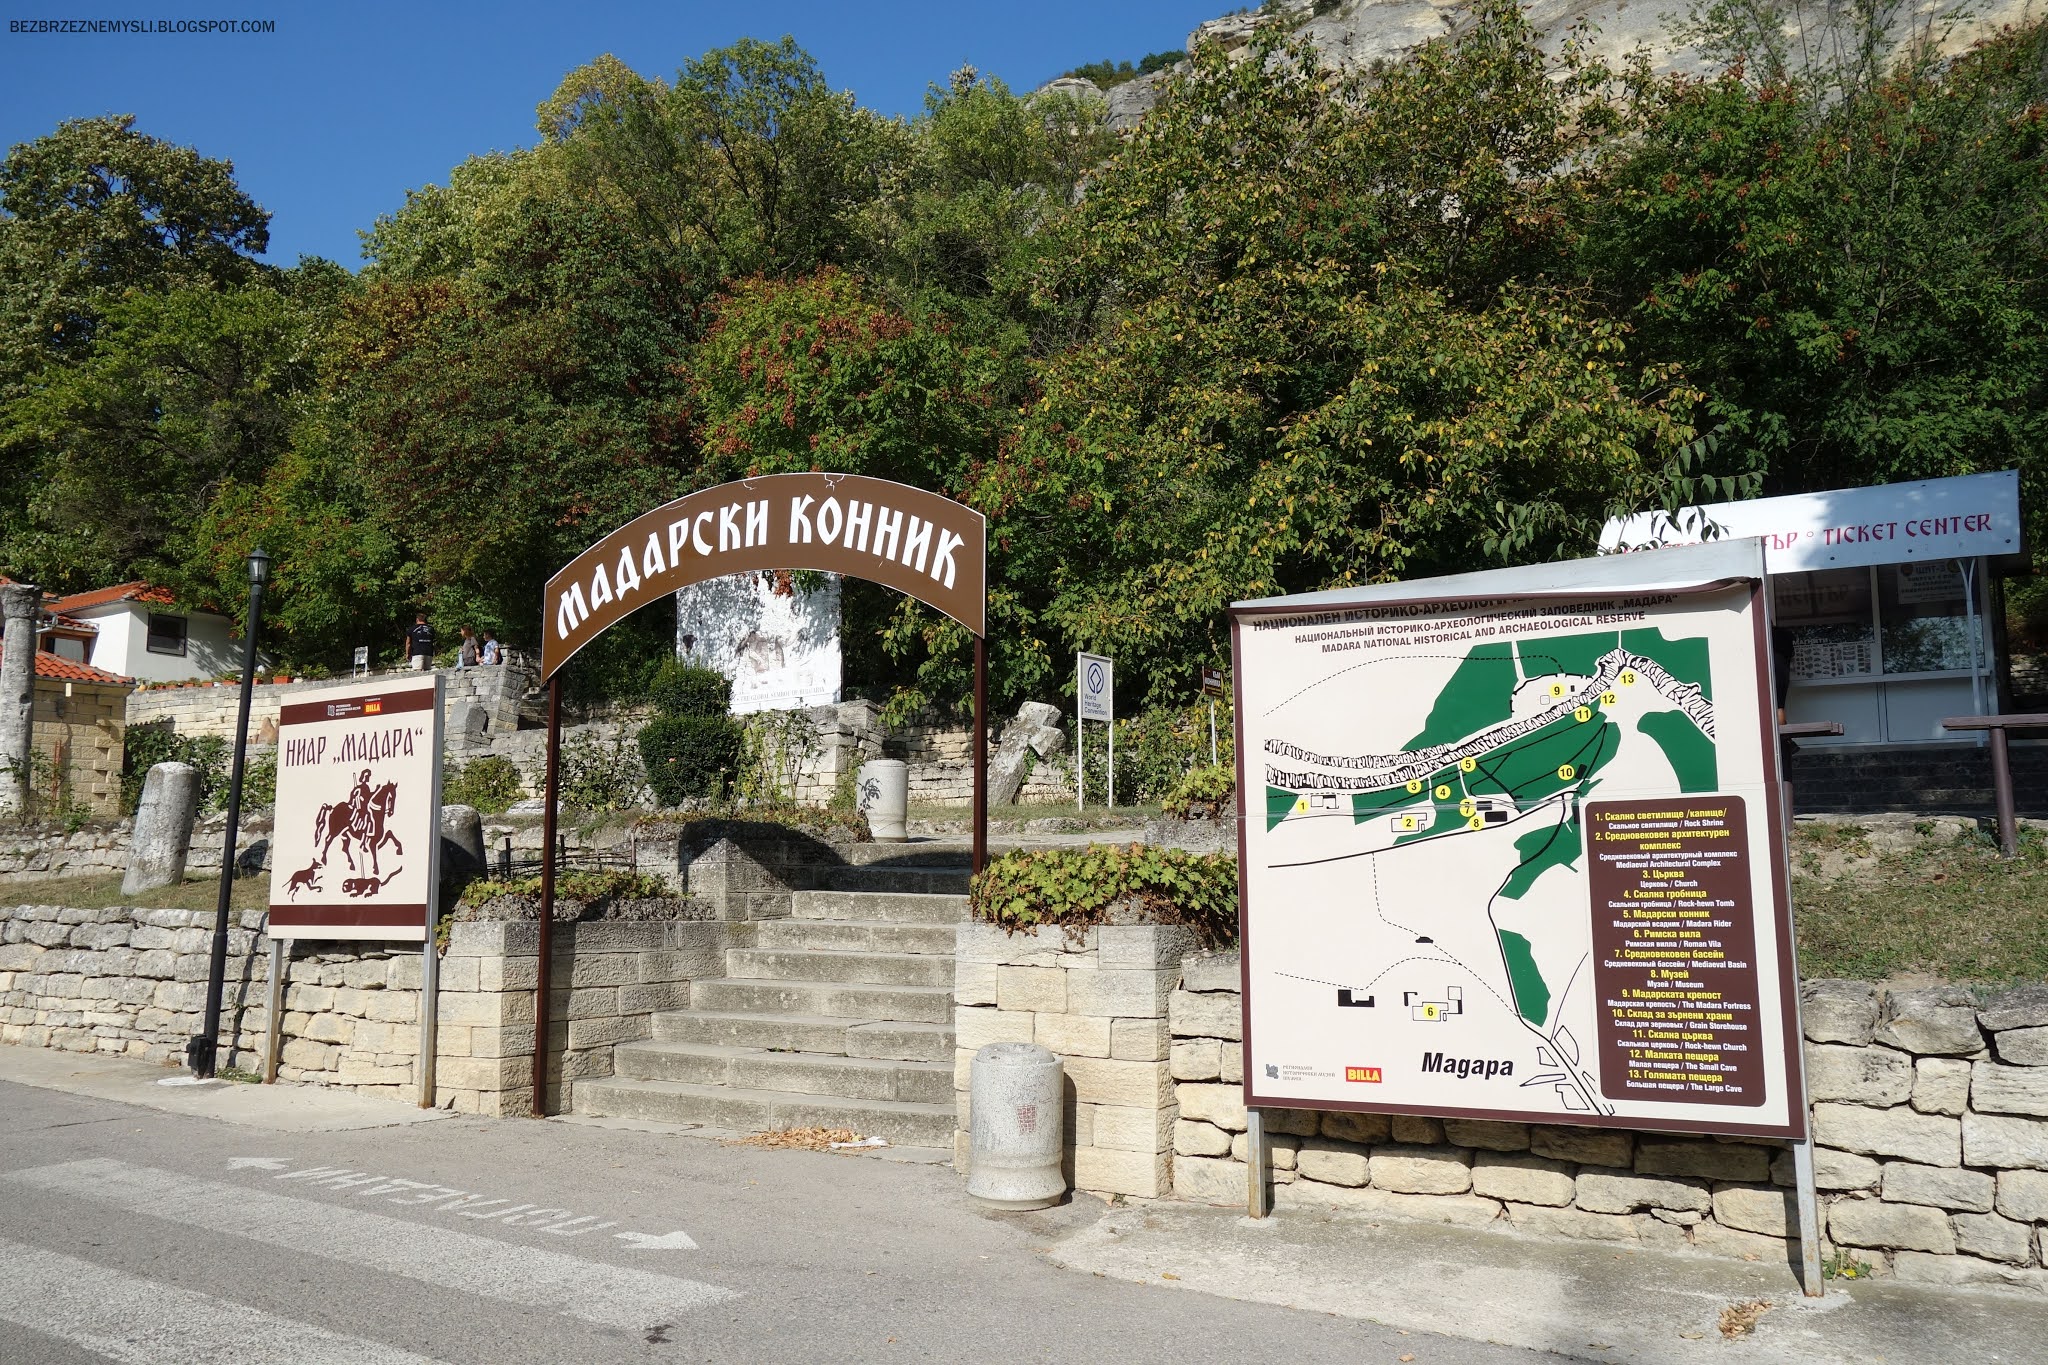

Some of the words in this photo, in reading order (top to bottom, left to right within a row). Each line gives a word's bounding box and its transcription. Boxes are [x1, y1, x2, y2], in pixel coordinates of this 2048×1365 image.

[1824, 522, 1897, 546] TICKET
[1905, 514, 1992, 537] CENTER
[557, 499, 768, 640] МАДАРСКИ
[790, 494, 964, 590] КОННИК
[1254, 612, 1340, 631] НАЦИОНАЛЕН
[1295, 625, 1374, 644] НАЦИОНАЛЬНЫЙ
[1377, 607, 1537, 636] ИСТОРИКО-АРХЕОЛОГИЧЕСКИЙ
[1540, 600, 1615, 616] ЗАПОВЕДНИК
[1322, 641, 1360, 653] MADARA
[1364, 638, 1411, 649] NATIONAL
[1414, 630, 1472, 646] HISTORICAL
[1475, 628, 1496, 638] AND
[1499, 616, 1592, 635] ARCHAEOLOGICAL
[1596, 611, 1645, 624] RESERVE
[1622, 674, 1634, 683] 13
[1554, 687, 1560, 695] 9
[1603, 695, 1615, 703] 12
[366, 704, 380, 712] BILLA
[1085, 700, 1101, 709] Heritage
[1084, 706, 1107, 716] Convention
[1578, 710, 1588, 718] 11
[286, 736, 326, 767] НИАР
[1466, 760, 1471, 768] 5
[1560, 768, 1572, 776] 10
[1595, 813, 1602, 821] 1.
[1605, 812, 1634, 820] Скално
[1637, 810, 1683, 819] светилище
[1686, 808, 1727, 818] /капище/
[1474, 819, 1479, 827] 8
[1605, 831, 1669, 840] Средновековен
[1672, 829, 1729, 838] архитектурен
[1640, 842, 1681, 850] комплекс
[1692, 860, 1721, 868] Complex
[1653, 870, 1684, 879] Църква
[1634, 890, 1664, 898] Скална
[1667, 890, 1706, 899] гробница
[1634, 910, 1676, 919] Мадарски
[1634, 930, 1642, 938] 6.
[1644, 930, 1677, 938] Римска
[1615, 950, 1622, 958] 7.
[1625, 950, 1690, 959] Средновековен
[1693, 950, 1724, 958] басейн
[1651, 970, 1658, 978] 8.
[1661, 970, 1689, 979] Музей
[1633, 990, 1684, 999] Мадарската
[1687, 992, 1721, 1000] крепост
[1428, 1008, 1433, 1016] 6
[1612, 1009, 1624, 1017] 10.
[1627, 1010, 1653, 1019] Склад
[1668, 1012, 1703, 1020] зърнени
[1706, 1013, 1732, 1021] храни
[1633, 1030, 1646, 1038] 11.
[1648, 1030, 1679, 1039] Скална
[1682, 1032, 1713, 1041] църква
[1630, 1050, 1642, 1058] 12.
[1645, 1051, 1682, 1060] Малката
[1685, 1053, 1718, 1062] пещера
[1348, 1068, 1380, 1082] BILLA
[1629, 1070, 1641, 1078] 13.
[1644, 1071, 1686, 1080] Голямата
[1689, 1073, 1722, 1082] пещера
